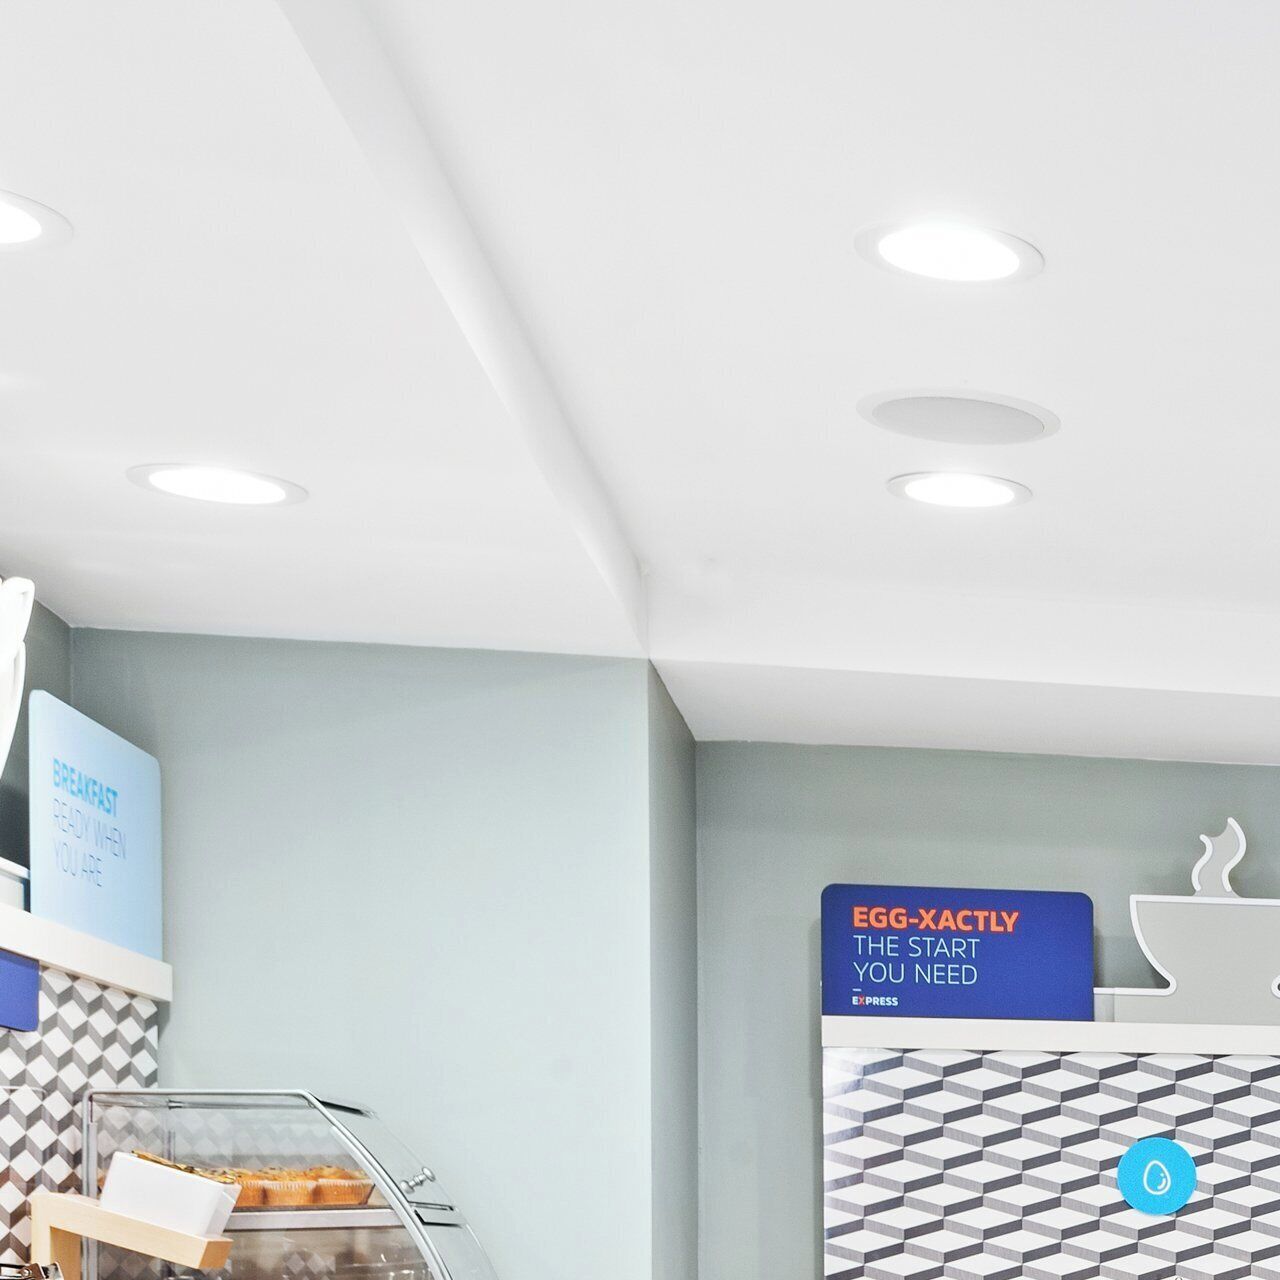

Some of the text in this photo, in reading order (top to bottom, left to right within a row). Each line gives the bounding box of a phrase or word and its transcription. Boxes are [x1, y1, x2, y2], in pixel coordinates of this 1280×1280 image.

[53, 758, 118, 818] BREAKFAST
[53, 798, 127, 860] READY WHEN
[53, 836, 102, 887] YOU ARE
[853, 906, 1019, 932] EGG-XACTLY
[853, 934, 980, 958] THE START
[853, 962, 978, 985] YOU NEED
[852, 995, 899, 1006] EXPRESS
